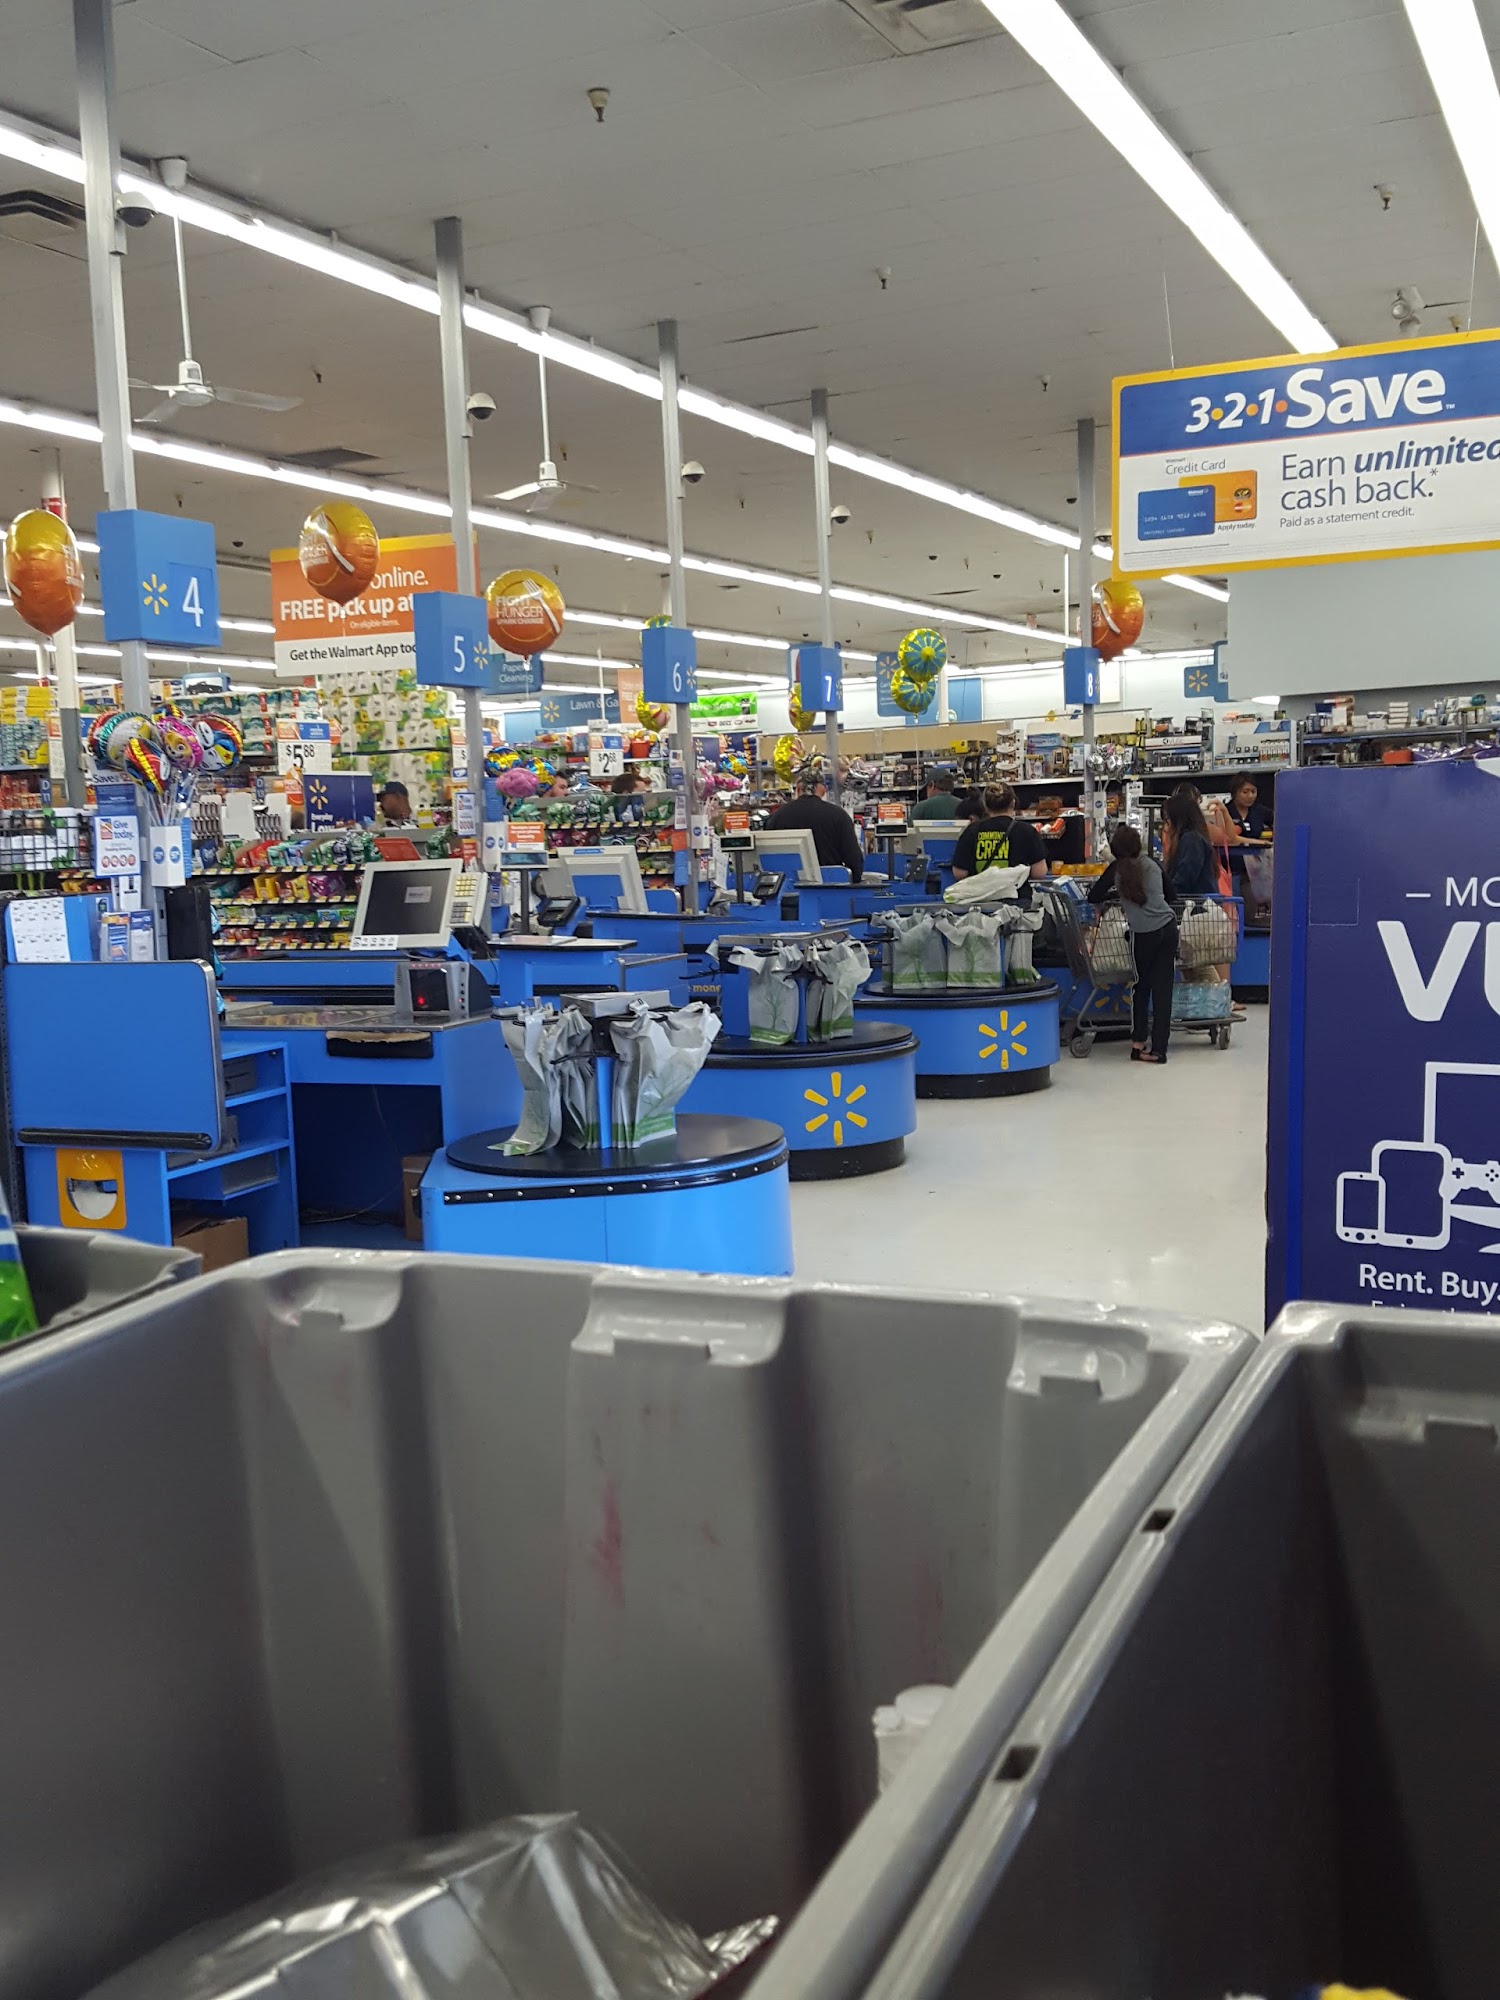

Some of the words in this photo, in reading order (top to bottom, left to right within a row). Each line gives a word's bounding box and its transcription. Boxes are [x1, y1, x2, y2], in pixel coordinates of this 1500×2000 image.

[1165, 462, 1198, 475] Credit
[1201, 459, 1226, 471] Card
[1282, 453, 1345, 481] Earn
[1281, 479, 1346, 511] cash
[1218, 523, 1236, 531] Apply
[1280, 516, 1302, 528] Paid
[1304, 518, 1315, 526] as
[1317, 517, 1324, 525] a
[1325, 510, 1379, 524] statement
[1382, 507, 1415, 519] credit.
[370, 565, 429, 590] online.
[183, 576, 204, 627] 4
[280, 598, 325, 621] FREE
[369, 600, 394, 619] up
[496, 606, 544, 618] HUNGER
[290, 649, 308, 661] Get
[310, 647, 328, 660] the
[329, 644, 374, 659] Walmart
[375, 643, 399, 659] App
[454, 635, 466, 673] 5
[499, 673, 534, 683] Cleaning
[672, 661, 681, 693] 6
[825, 675, 832, 703] 7
[1087, 672, 1094, 698] 8
[570, 699, 595, 710] Lawn
[113, 820, 128, 829] Give
[1359, 1263, 1433, 1294] Rent.
